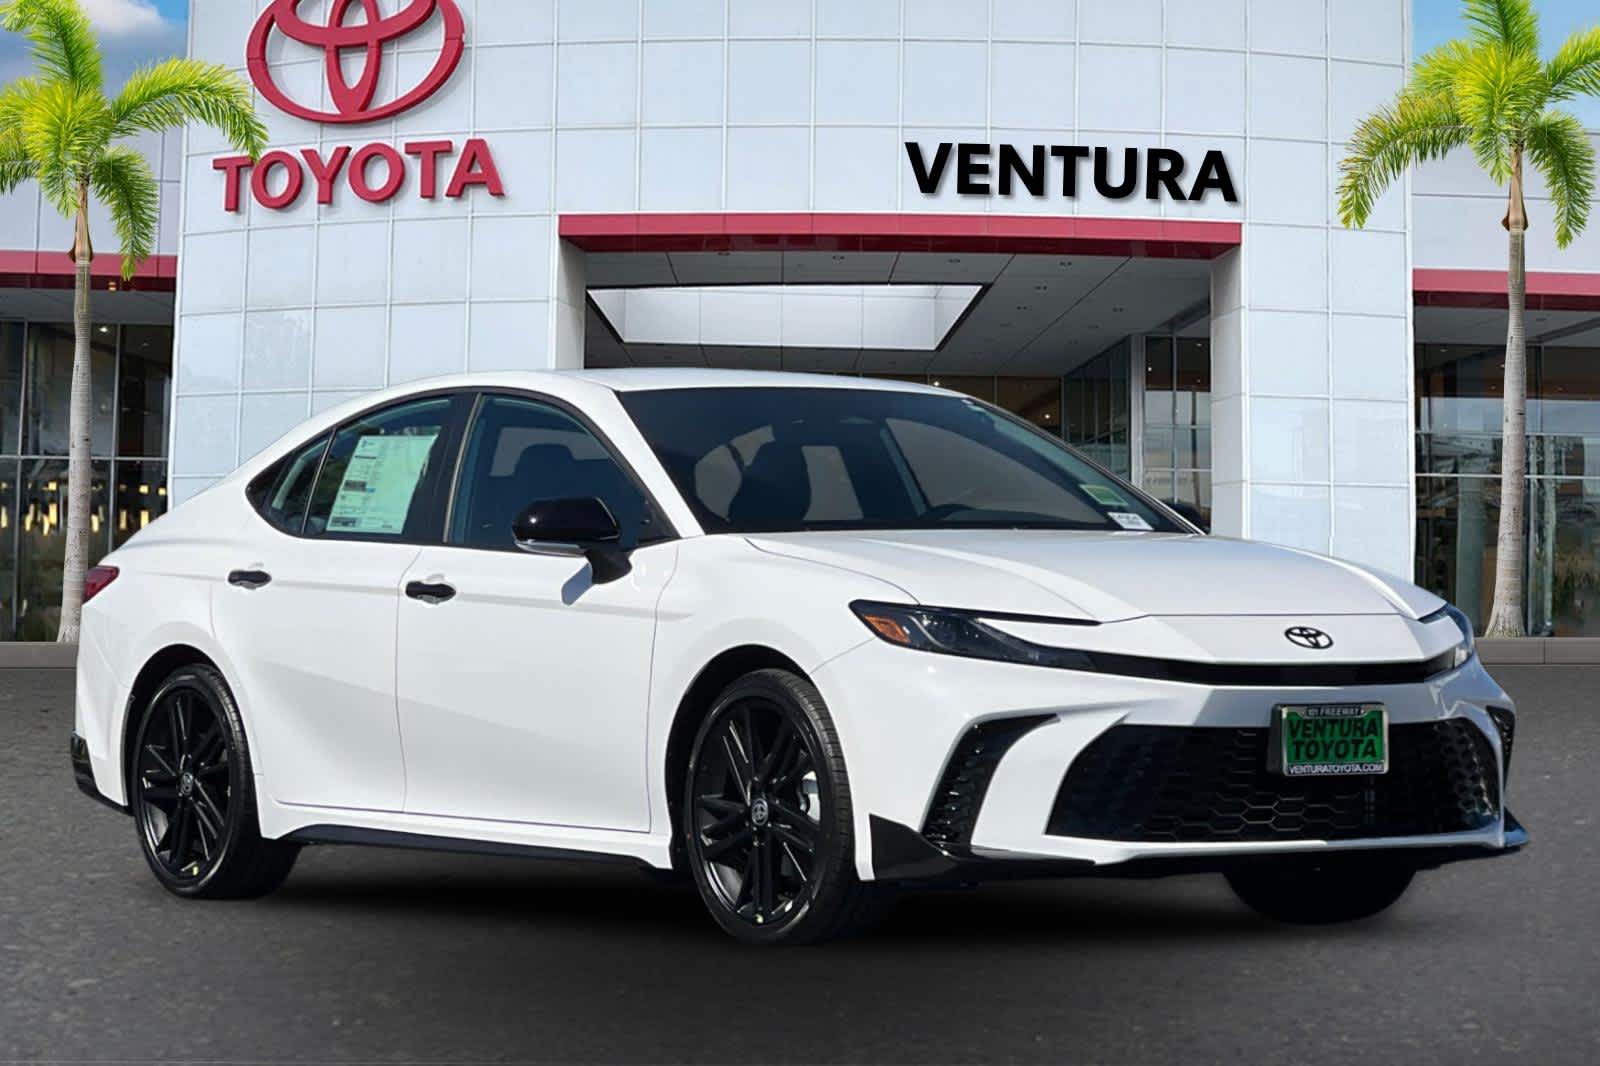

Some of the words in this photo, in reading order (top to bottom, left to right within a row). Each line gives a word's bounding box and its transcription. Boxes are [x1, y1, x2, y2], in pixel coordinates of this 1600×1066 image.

[212, 138, 505, 212] TOYOTA
[904, 141, 1239, 203] VENTURA
[1288, 718, 1378, 738] VENTURA
[1293, 738, 1377, 760] TOYOTA
[1290, 763, 1384, 774] VENTURATOYOTA.COM
